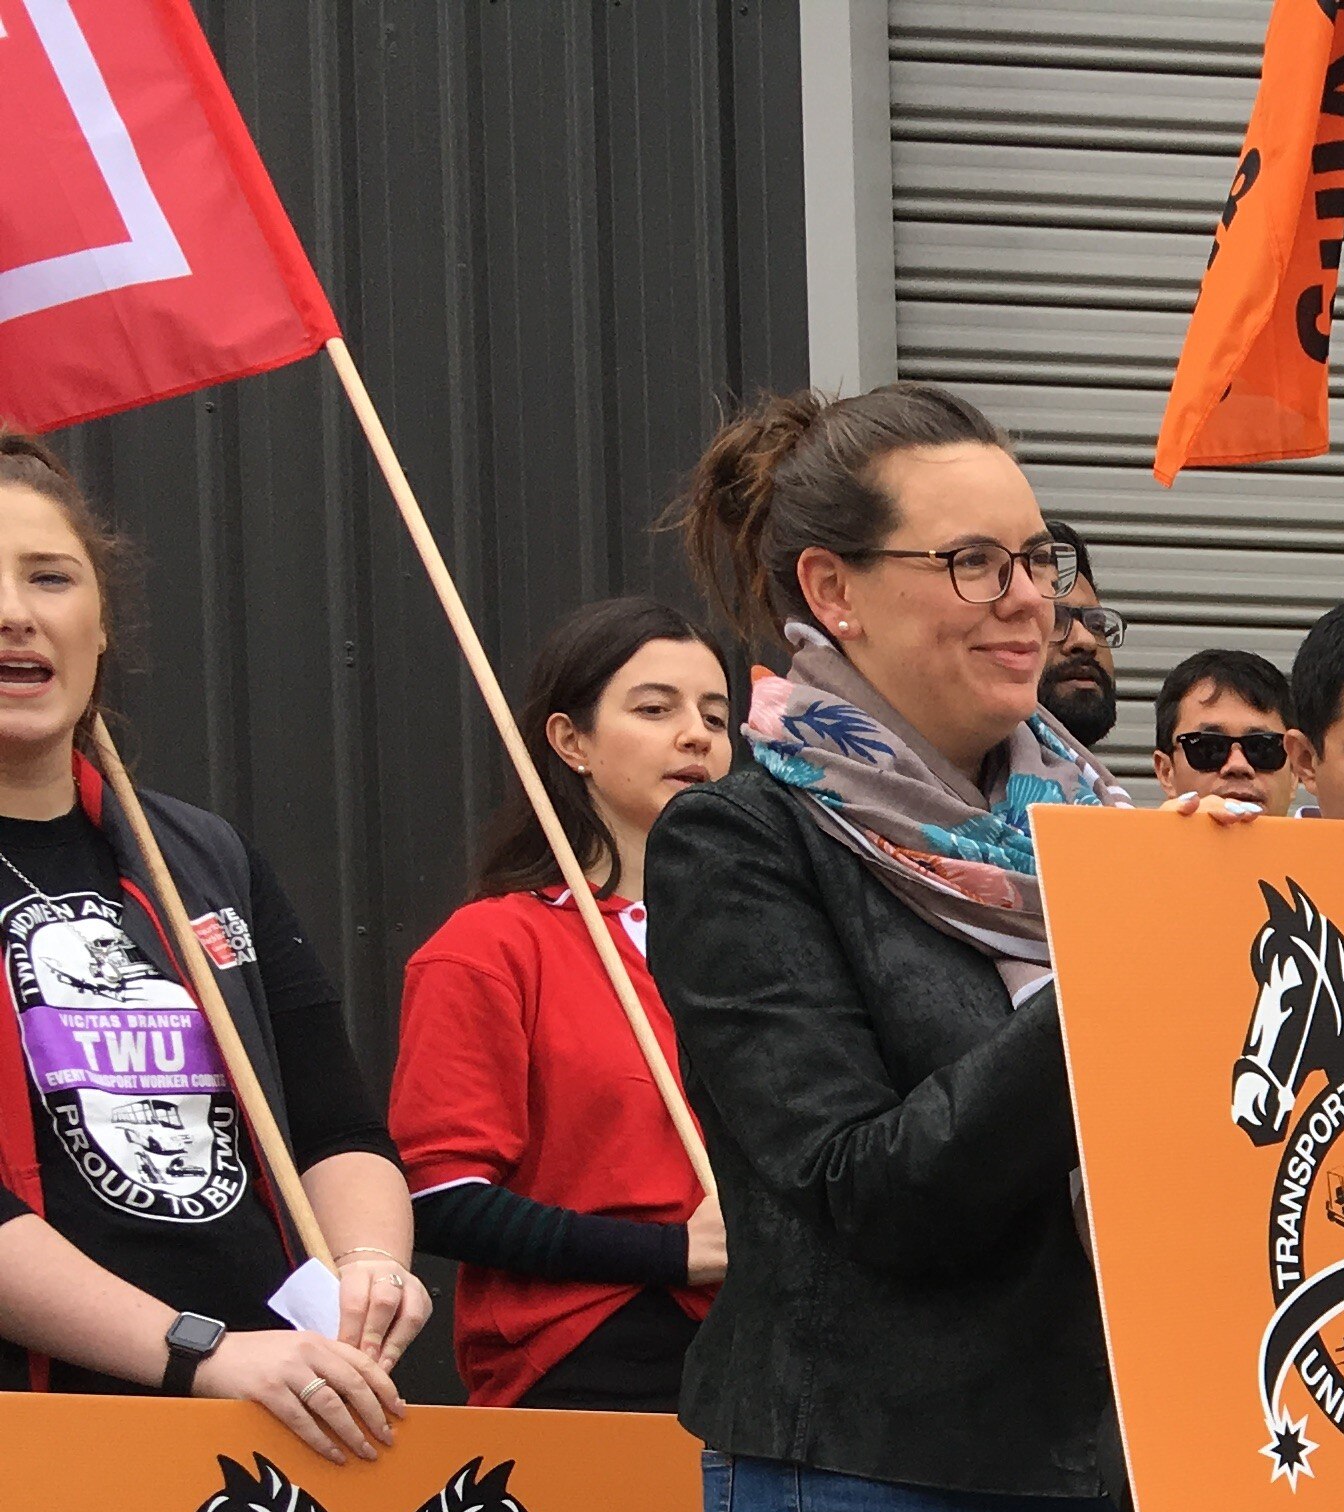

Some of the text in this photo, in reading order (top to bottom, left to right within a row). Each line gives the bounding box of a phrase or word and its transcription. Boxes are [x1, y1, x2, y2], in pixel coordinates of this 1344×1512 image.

[9, 901, 76, 941] WOMEN
[59, 1015, 191, 1029] VIC/TAS BRANCH
[73, 1030, 186, 1073] TWU
[139, 1074, 189, 1088] WORKER
[55, 1104, 239, 1217] PROUD TO BE TWU
